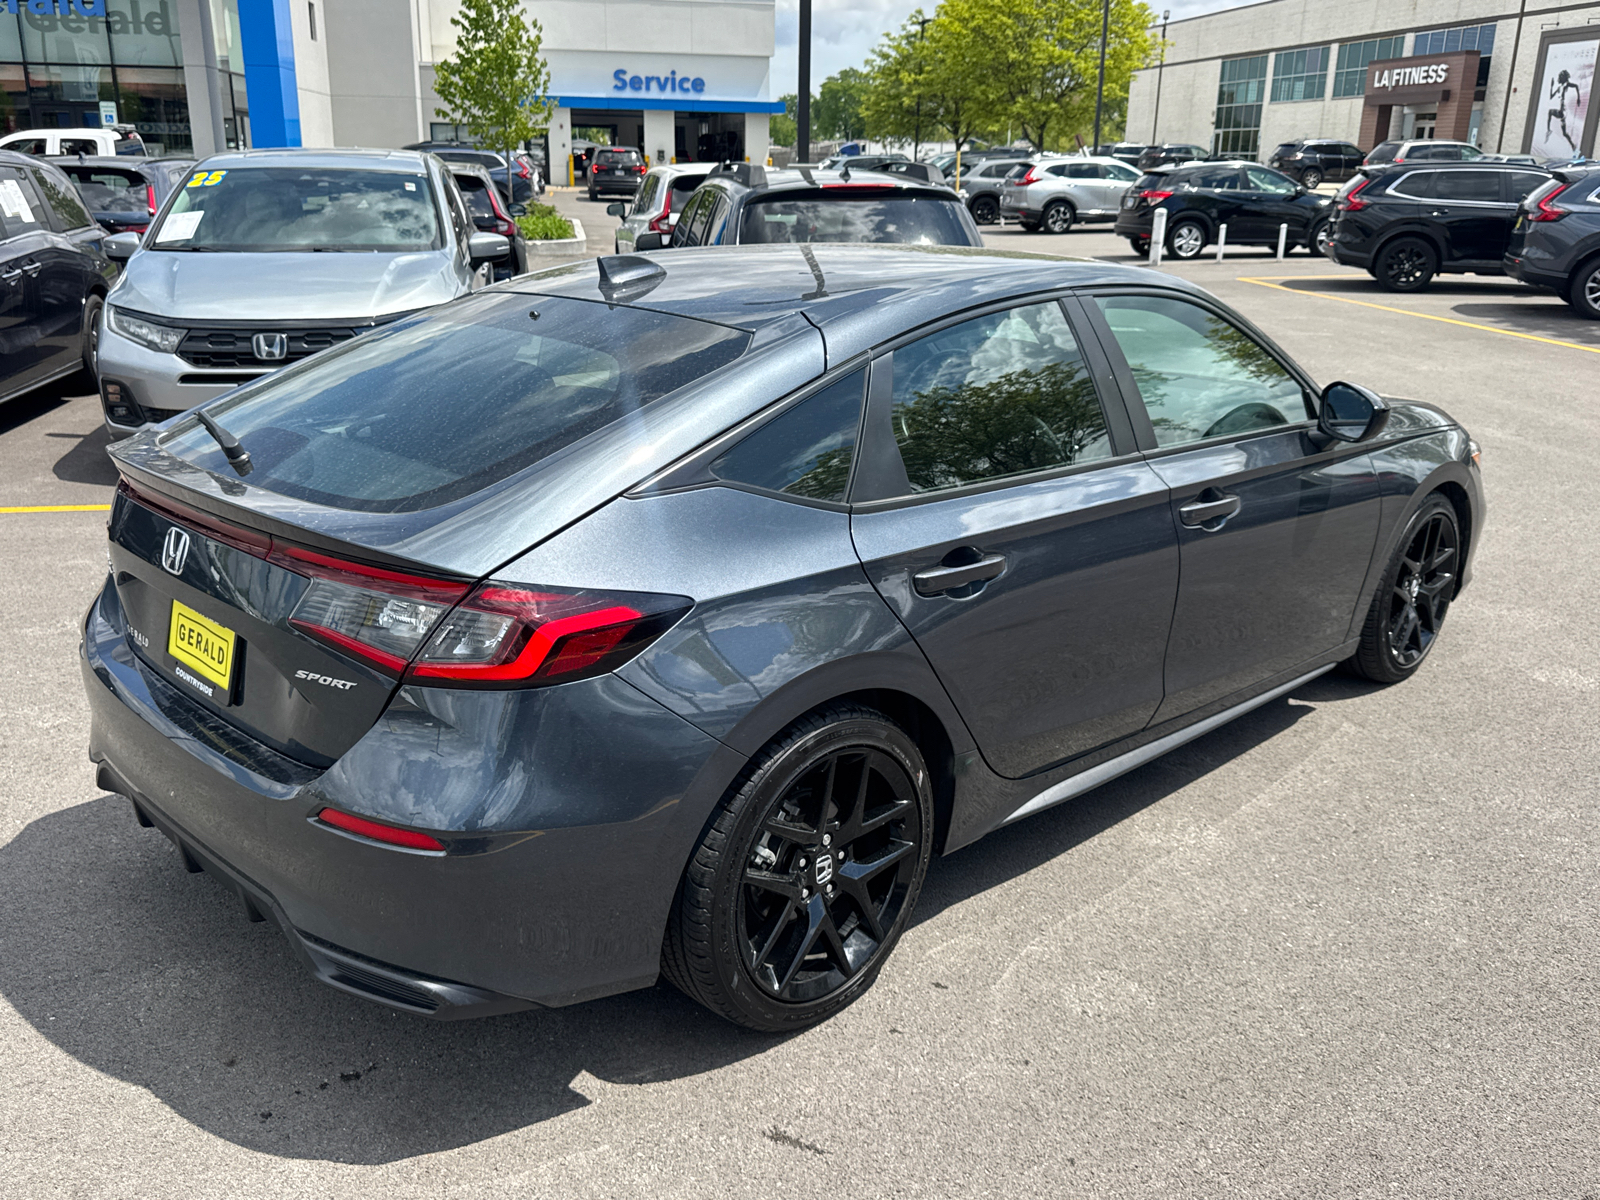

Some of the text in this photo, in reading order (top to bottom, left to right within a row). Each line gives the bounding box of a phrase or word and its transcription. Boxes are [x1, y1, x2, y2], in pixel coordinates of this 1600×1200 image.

[613, 69, 705, 93] Service
[135, 123, 191, 133] ONDA
[187, 171, 226, 187] 25
[127, 624, 149, 648] GERALD
[178, 623, 225, 665] GERALD
[175, 667, 213, 697] COUNTRYSIDE
[294, 669, 358, 690] SPORT
